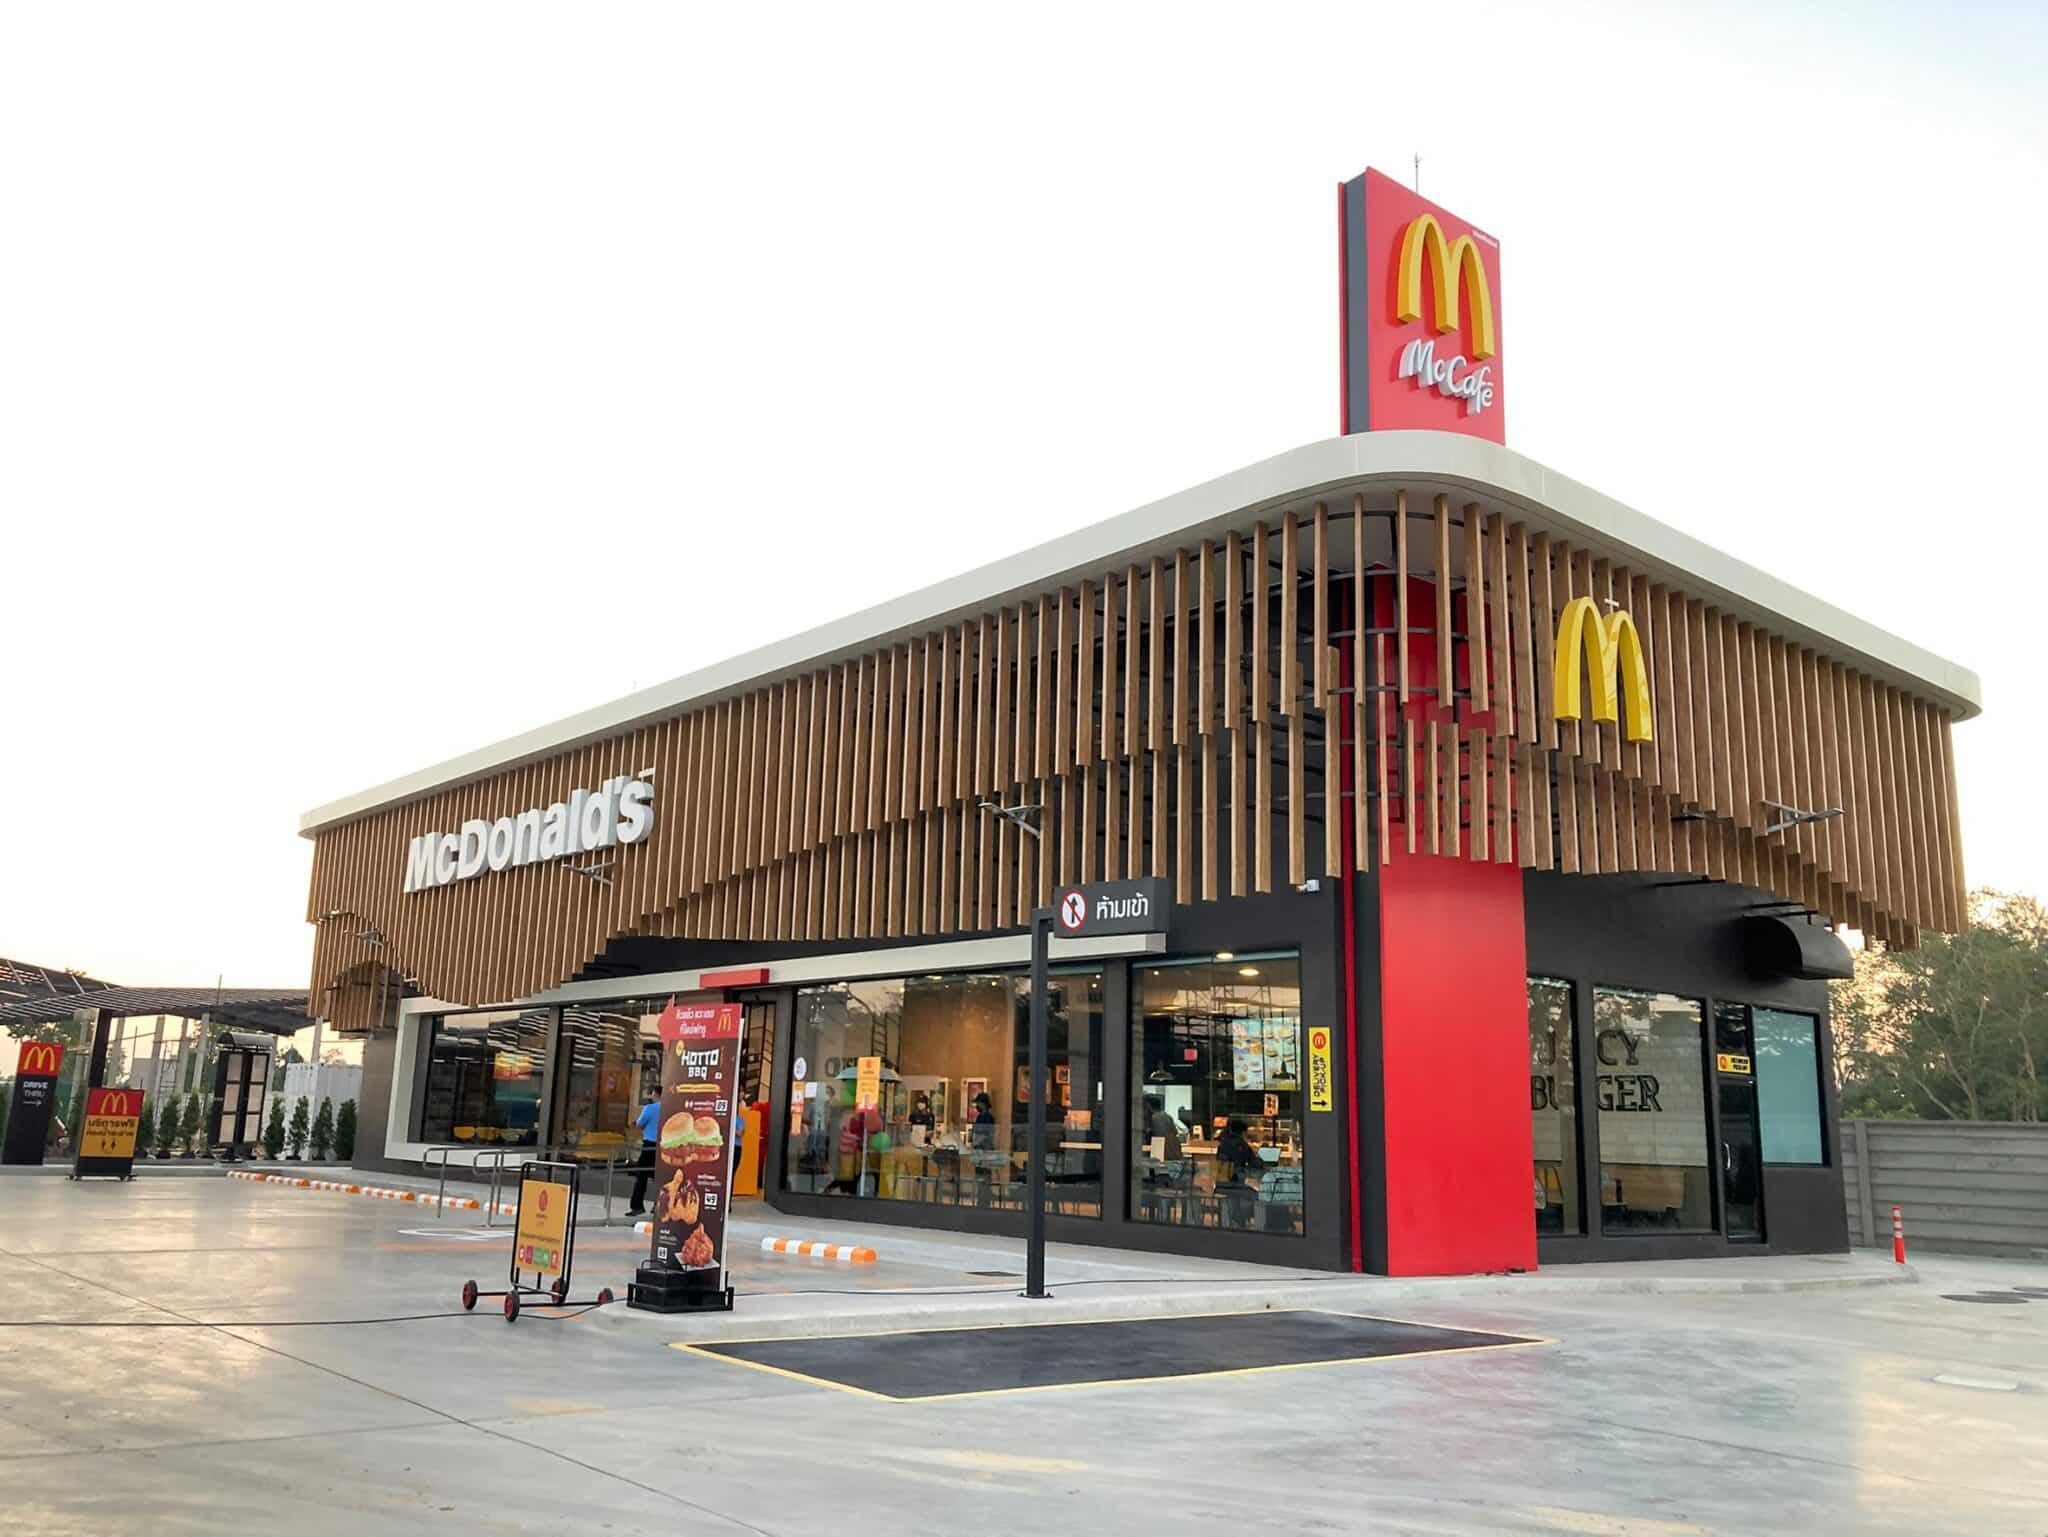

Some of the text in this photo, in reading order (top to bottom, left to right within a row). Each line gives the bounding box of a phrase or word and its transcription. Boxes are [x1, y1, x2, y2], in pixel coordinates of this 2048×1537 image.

[1399, 338, 1494, 416] McCafé
[403, 775, 655, 893] McDonald's
[1096, 891, 1149, 920] ห้ามเข้า
[23, 1081, 49, 1089] DRIVE
[688, 1066, 707, 1080] BBQ
[1312, 1053, 1320, 1097] DELIVERY
